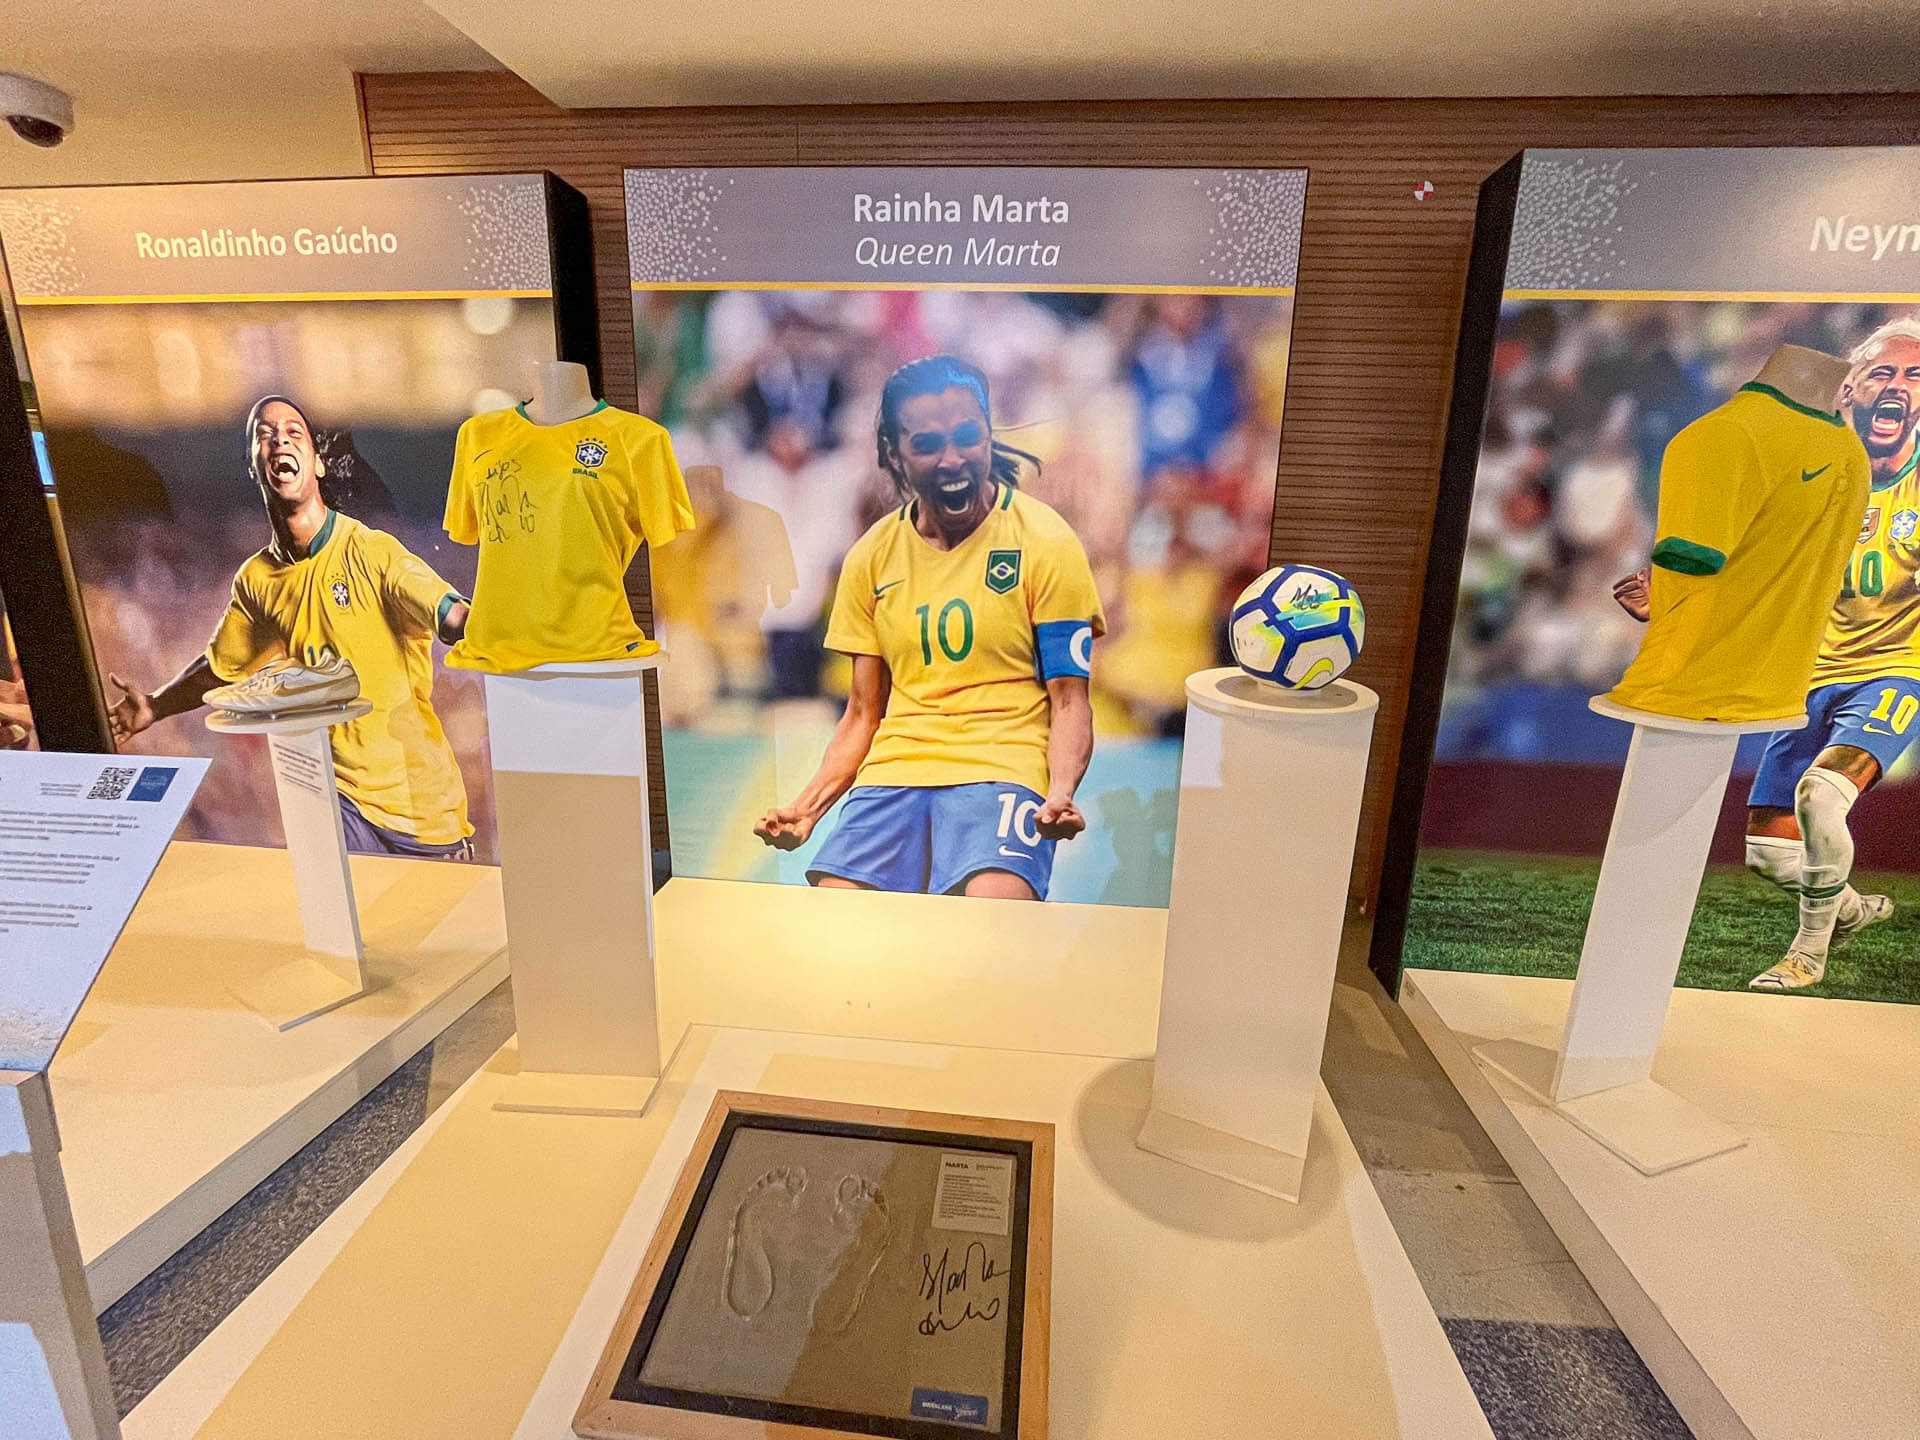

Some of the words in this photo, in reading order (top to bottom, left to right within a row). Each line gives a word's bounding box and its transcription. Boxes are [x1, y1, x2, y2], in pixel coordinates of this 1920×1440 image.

[854, 192, 961, 223] Rainha
[972, 193, 1069, 223] Marta
[135, 228, 287, 259] Ronaldinho
[293, 225, 398, 256] Gaúcho
[855, 237, 953, 268] Queen
[963, 237, 1061, 267] Marta
[915, 598, 974, 666] 10
[1868, 687, 1919, 735] 10
[996, 792, 1042, 848] 10
